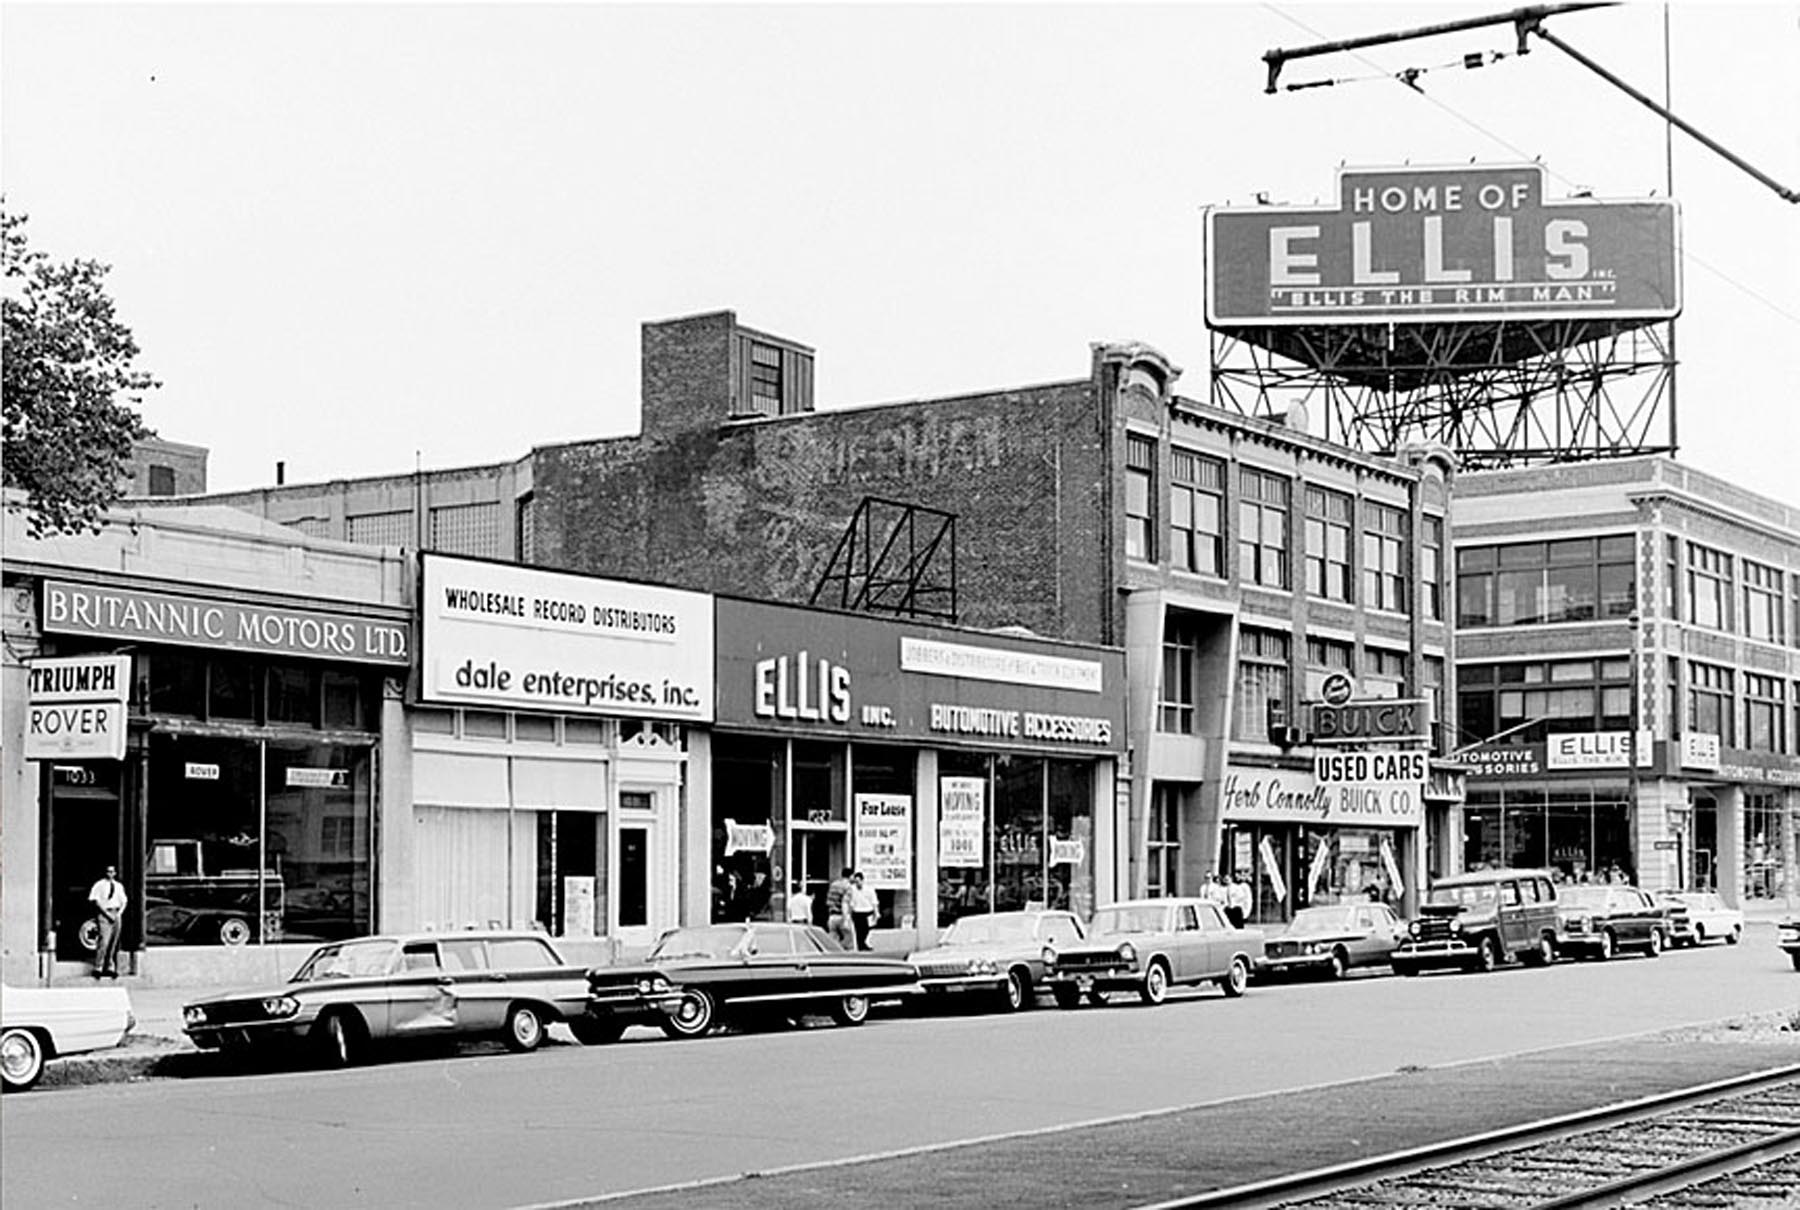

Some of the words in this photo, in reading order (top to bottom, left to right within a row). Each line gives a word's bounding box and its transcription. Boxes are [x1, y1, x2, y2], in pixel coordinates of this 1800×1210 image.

[1354, 185, 1462, 213] HOME
[1478, 184, 1531, 209] OF
[1270, 216, 1590, 285] ELLIS
[1381, 289, 1434, 304] THE
[1455, 288, 1506, 303] RIM
[50, 590, 225, 638] BRITANNIC
[238, 611, 356, 655] MOTORS
[365, 627, 408, 657] LTD.
[445, 587, 525, 617] WHOLESALE
[534, 599, 586, 624] RECORD
[593, 606, 676, 634] DISTRIBUTORS
[30, 665, 116, 693] TRIUMPH
[455, 659, 511, 691] dale
[523, 672, 657, 706] enterprises,
[663, 680, 700, 707] inc.
[755, 651, 851, 722] ELLIS
[31, 708, 107, 734] ROVER
[862, 705, 897, 727] INC.
[930, 703, 1019, 737] AUTOMOTIVE
[1023, 711, 1111, 743] ACCESSORIES
[1320, 706, 1415, 734] BUICK
[1453, 750, 1532, 763] UTOMOTIVE
[1560, 734, 1631, 756] ELLIS
[1318, 756, 1367, 782] USED
[1374, 754, 1424, 781] CARS
[861, 800, 879, 816] For
[880, 801, 906, 816] Lease
[1225, 775, 1260, 810] Herb
[1266, 779, 1332, 819] Connolly
[1340, 787, 1382, 814] BUICK
[1390, 790, 1415, 815] CO.
[1000, 832, 1037, 852] ELLIS
